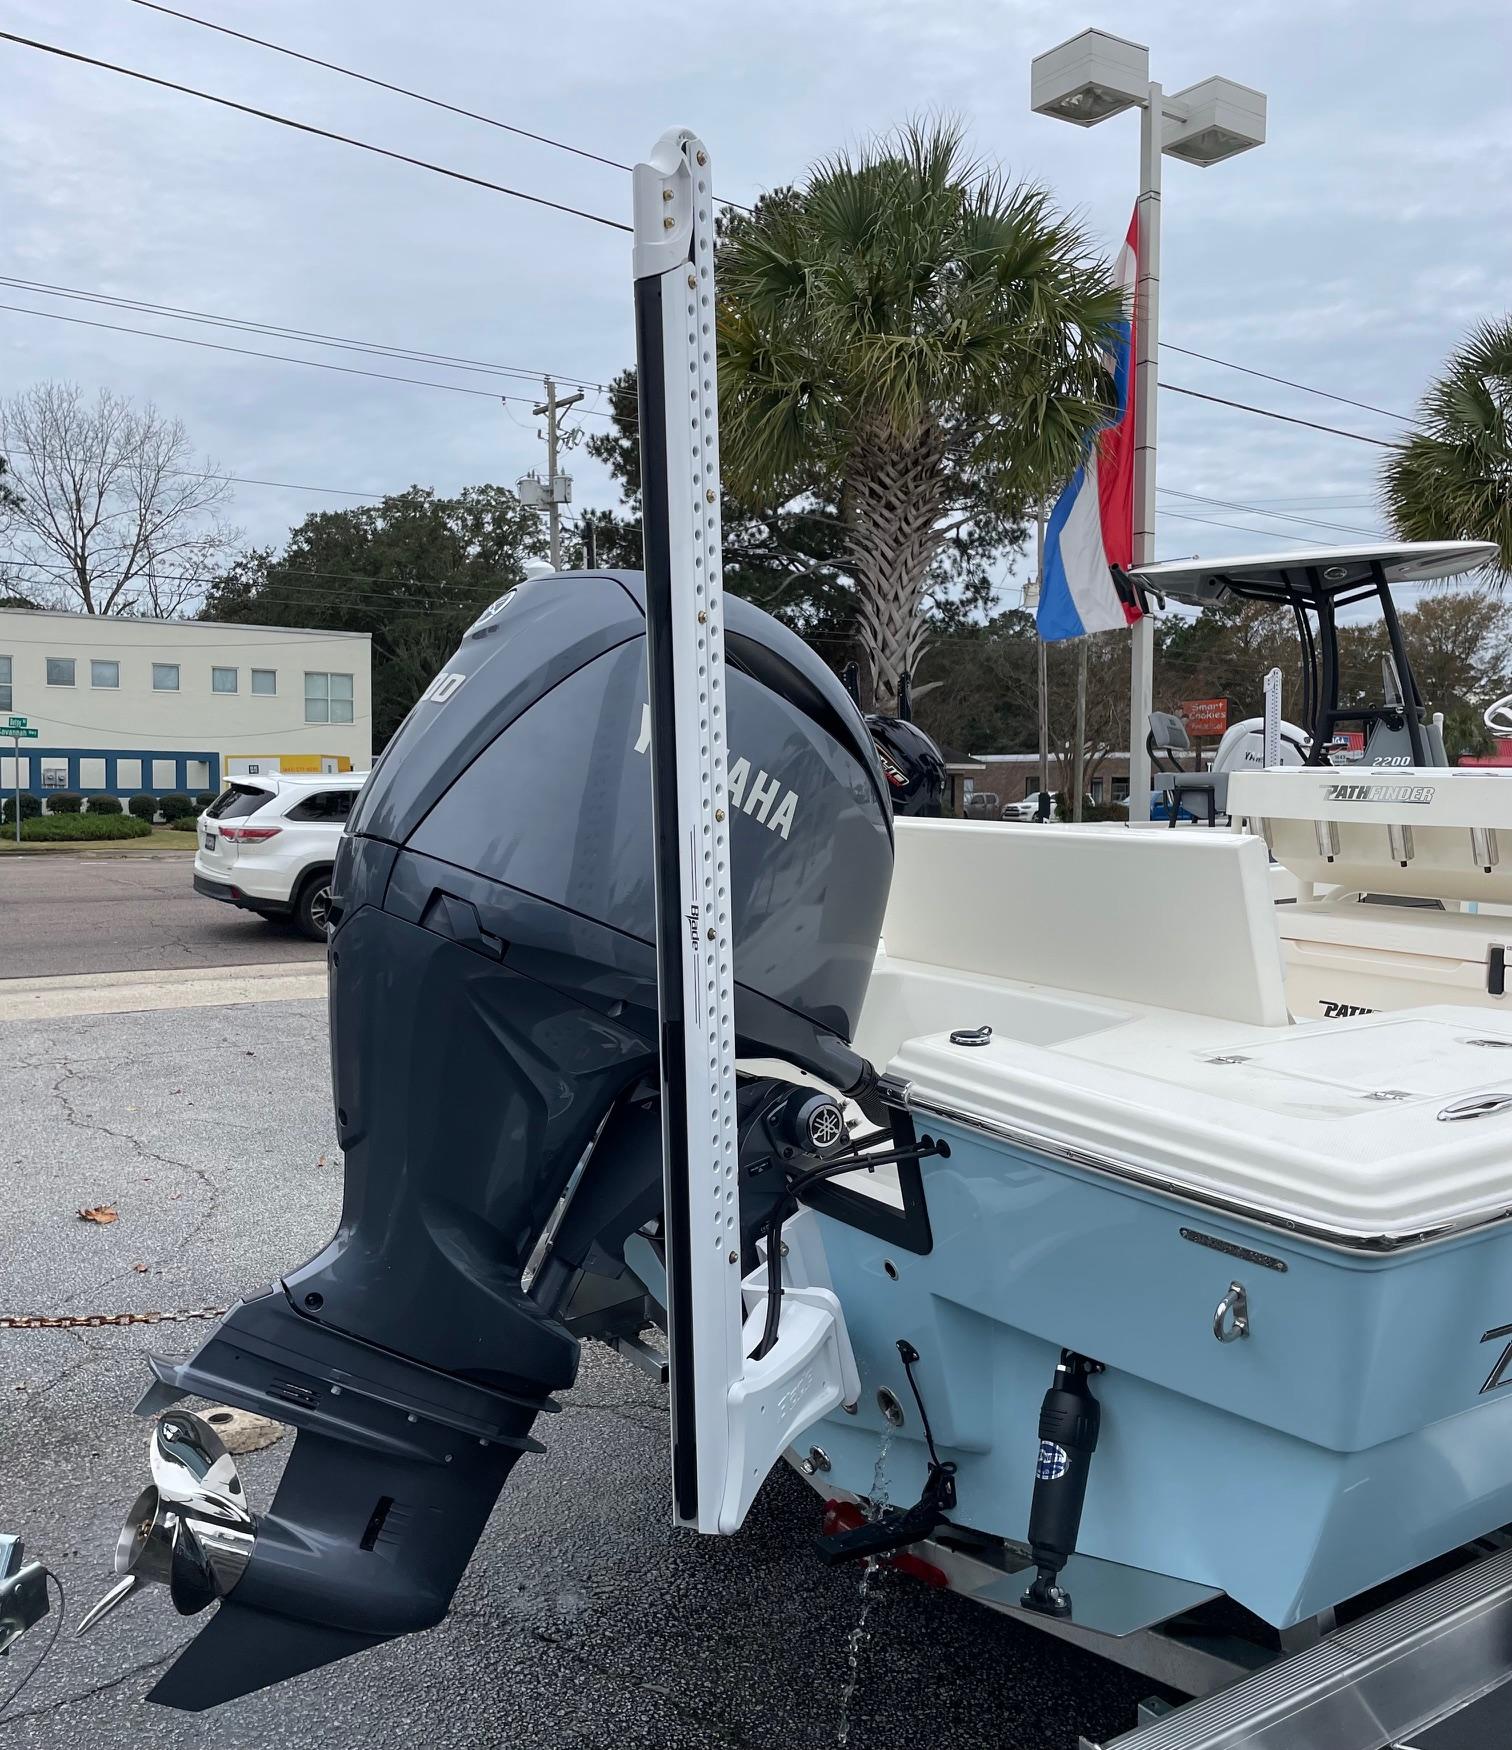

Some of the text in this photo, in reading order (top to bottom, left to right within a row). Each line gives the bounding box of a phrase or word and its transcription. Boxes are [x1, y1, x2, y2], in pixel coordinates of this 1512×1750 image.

[1191, 702, 1224, 712] Smart
[1189, 710, 1226, 720] Cookies
[0, 729, 28, 737] avannah
[1372, 756, 1411, 767] 2200
[1319, 784, 1436, 804] PATHFINDER
[684, 904, 700, 951] Blade
